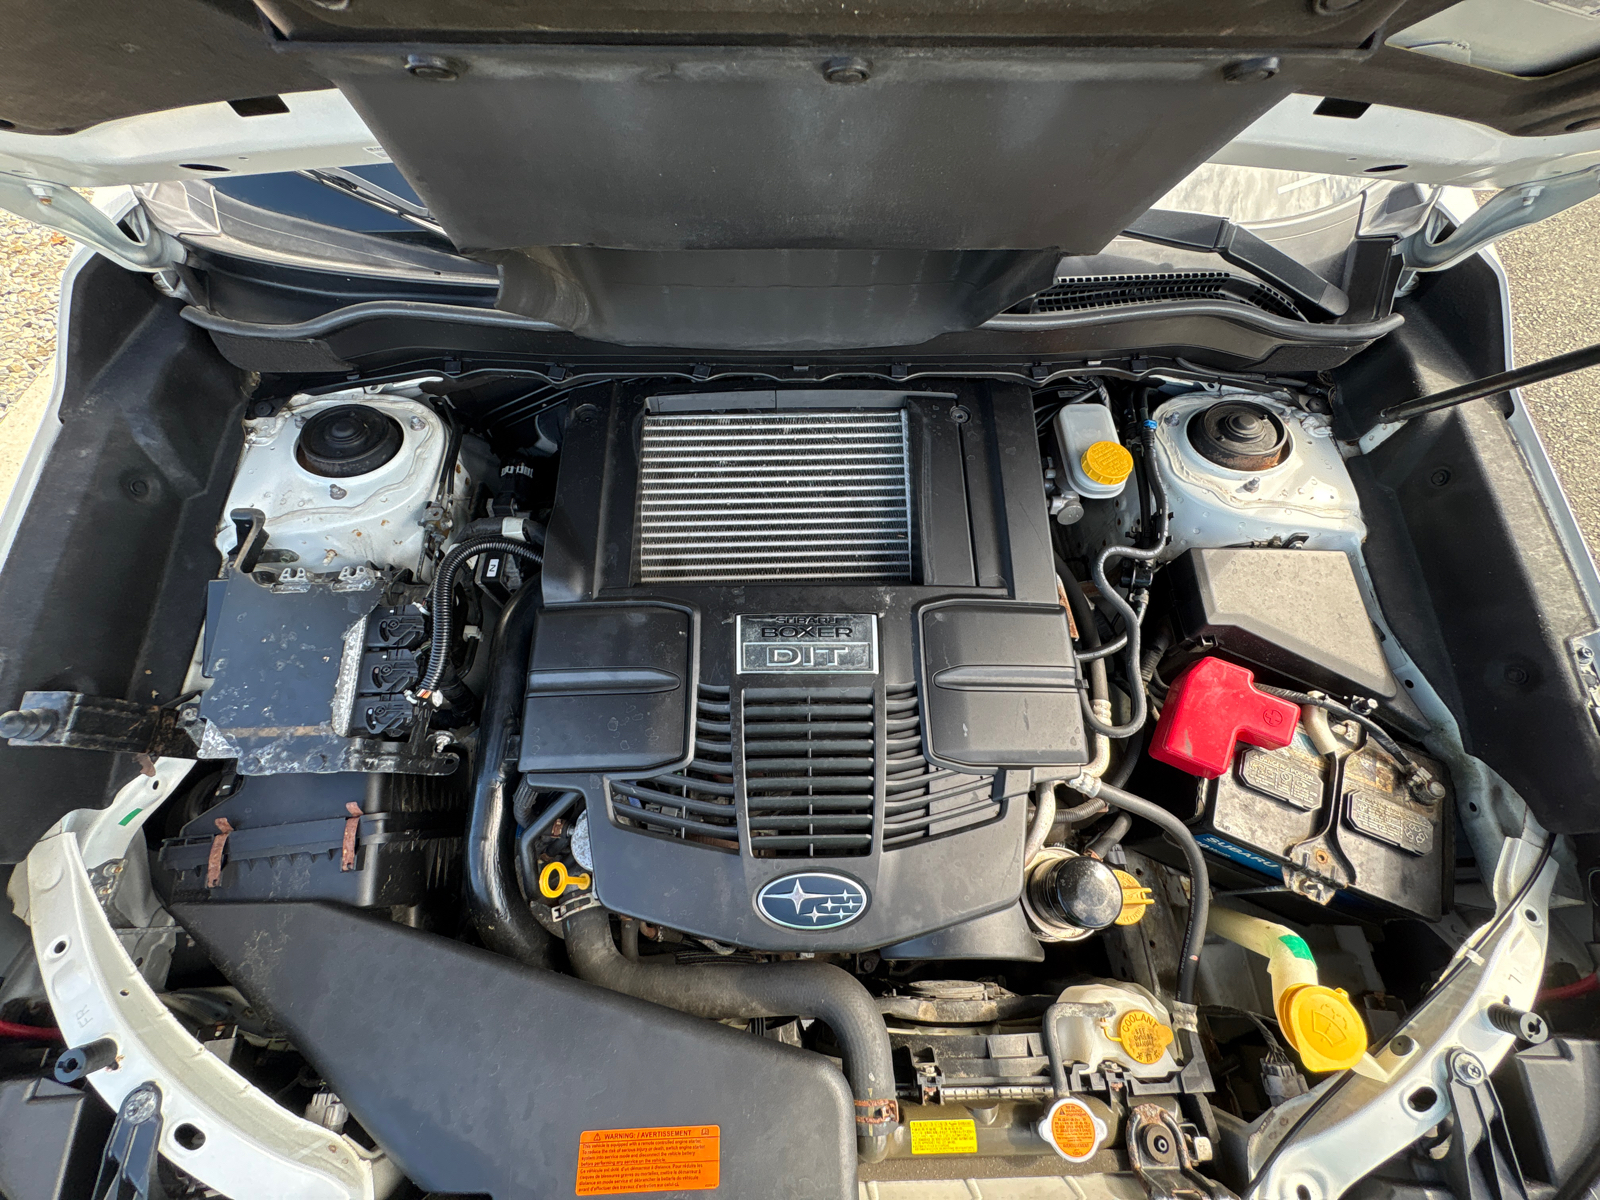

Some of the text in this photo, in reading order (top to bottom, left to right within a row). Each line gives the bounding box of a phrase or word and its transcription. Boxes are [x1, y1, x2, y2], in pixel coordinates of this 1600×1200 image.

[776, 616, 839, 624] SUBARU
[761, 626, 853, 638] BOXER
[766, 646, 849, 666] DIT
[1204, 837, 1279, 868] SUBARU
[1122, 1014, 1158, 1032] COOLANT
[640, 1129, 691, 1138] AVERTISSEMENT
